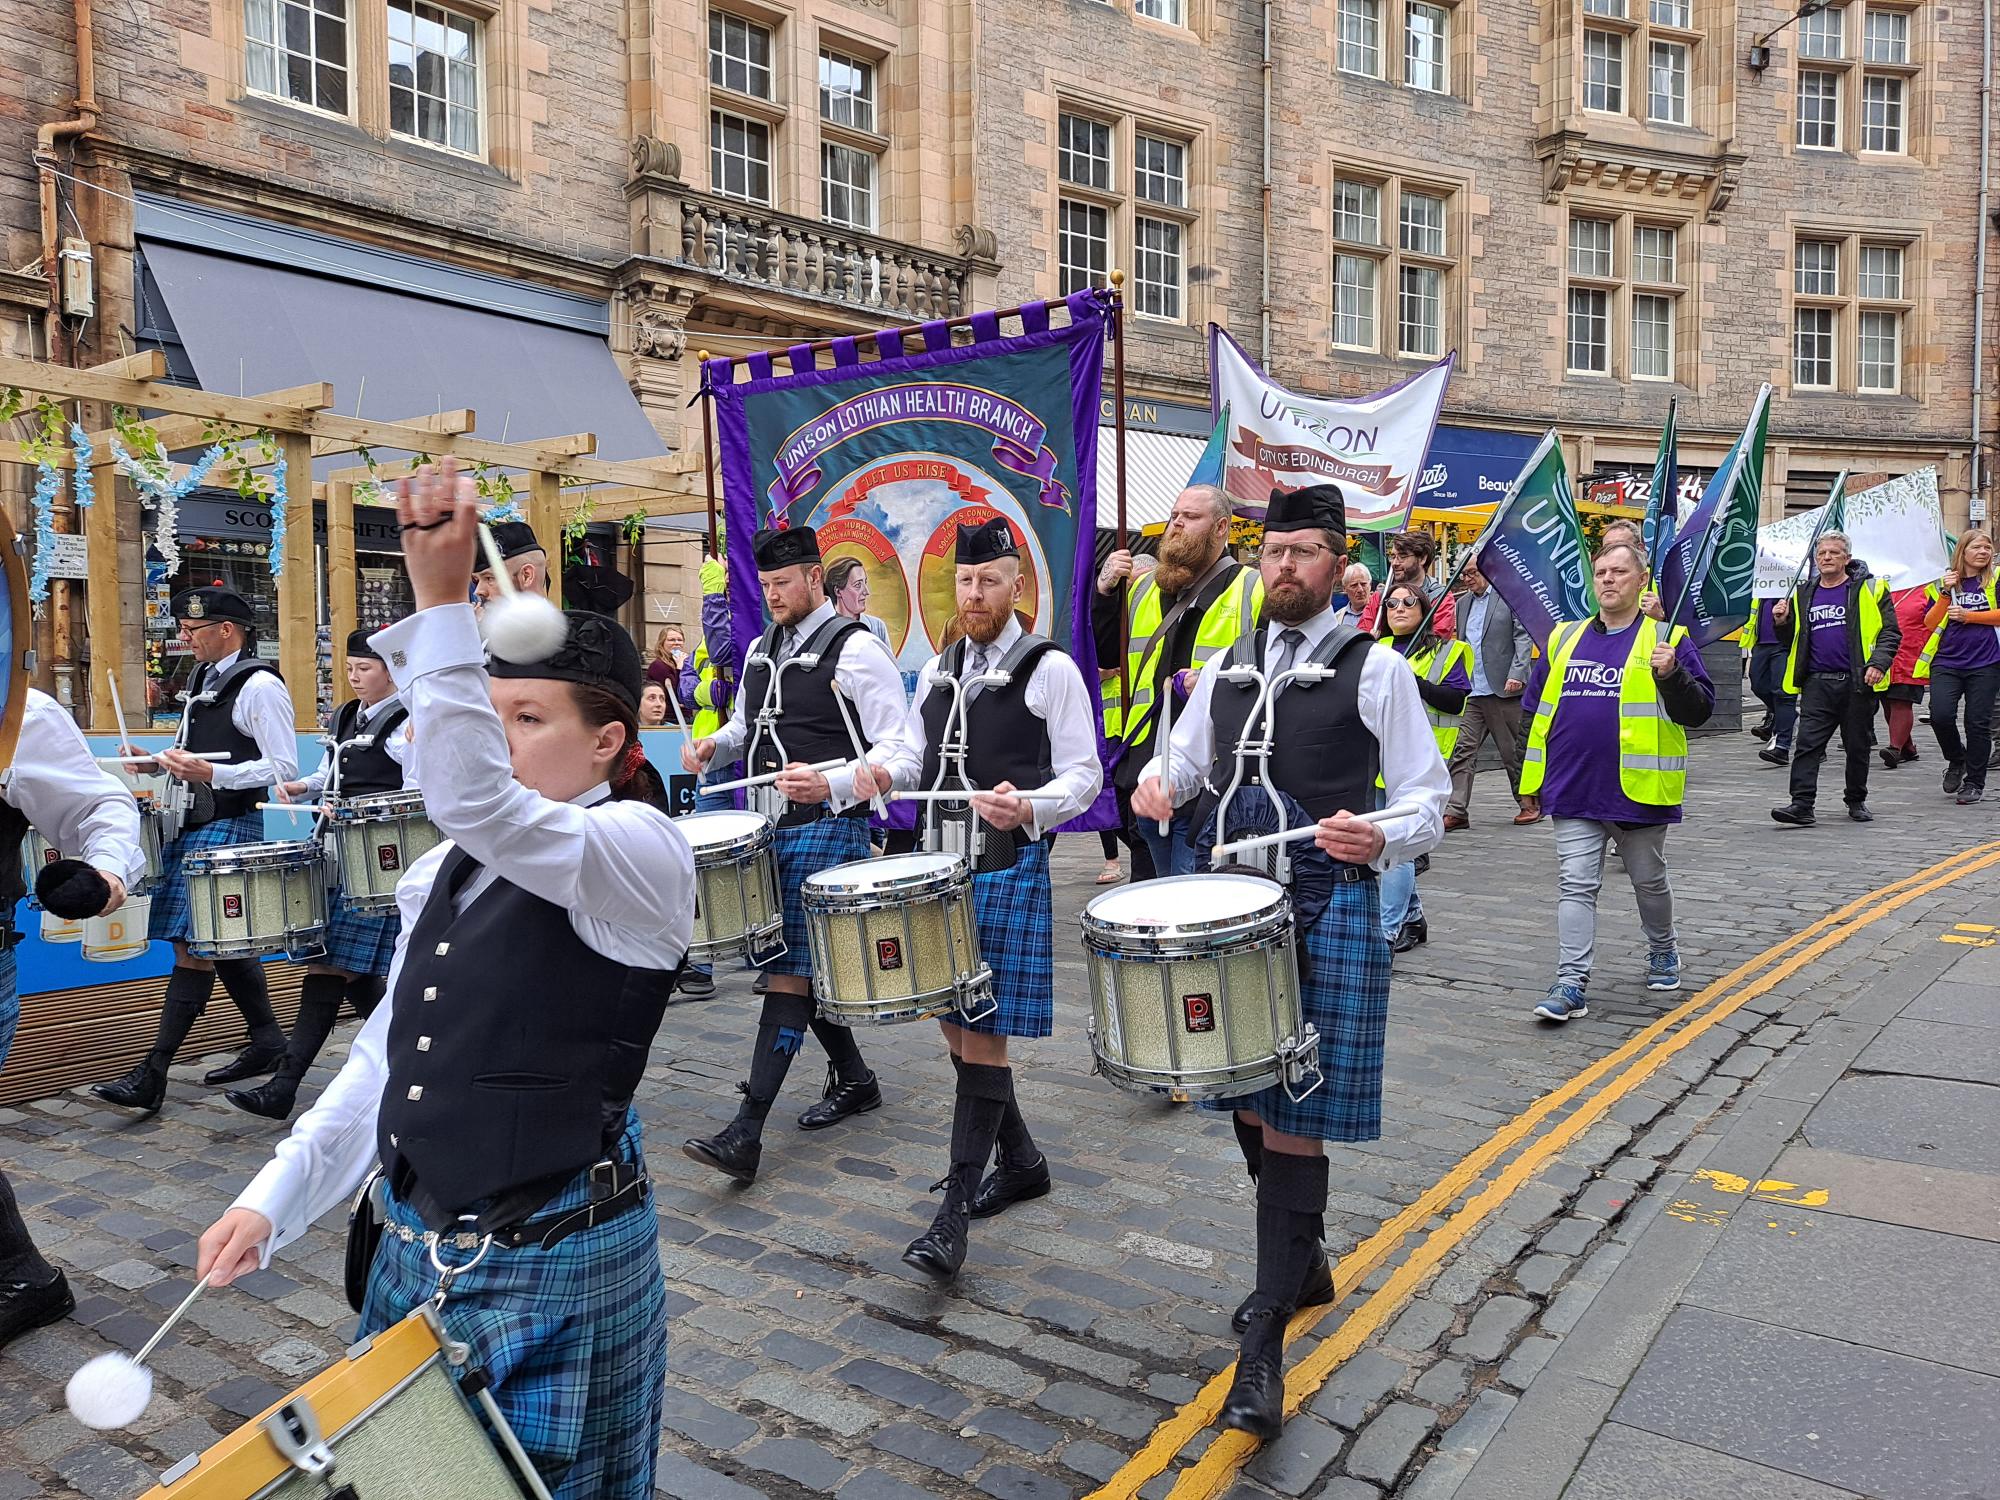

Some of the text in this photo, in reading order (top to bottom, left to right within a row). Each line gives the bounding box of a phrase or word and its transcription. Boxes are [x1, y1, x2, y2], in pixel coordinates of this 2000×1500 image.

[784, 390, 1034, 471] UNISON LOTHIAN HEALTH BRANCH
[1260, 390, 1379, 453] UNON
[894, 463, 909, 479] US
[1259, 447, 1381, 484] CITY OF EDINBURGH
[1417, 463, 1448, 494] ots
[1478, 475, 1513, 493] Beaut
[1432, 490, 1458, 499] Since 1849
[1595, 490, 1618, 504] Pizza
[941, 512, 965, 533] JAMES
[1759, 562, 1786, 573] public
[1492, 534, 1566, 624] Lothian Health
[1753, 577, 1775, 589] for
[1688, 579, 1714, 628] Branch
[1808, 605, 1846, 623] UNISO
[1581, 689, 1607, 698] Health
